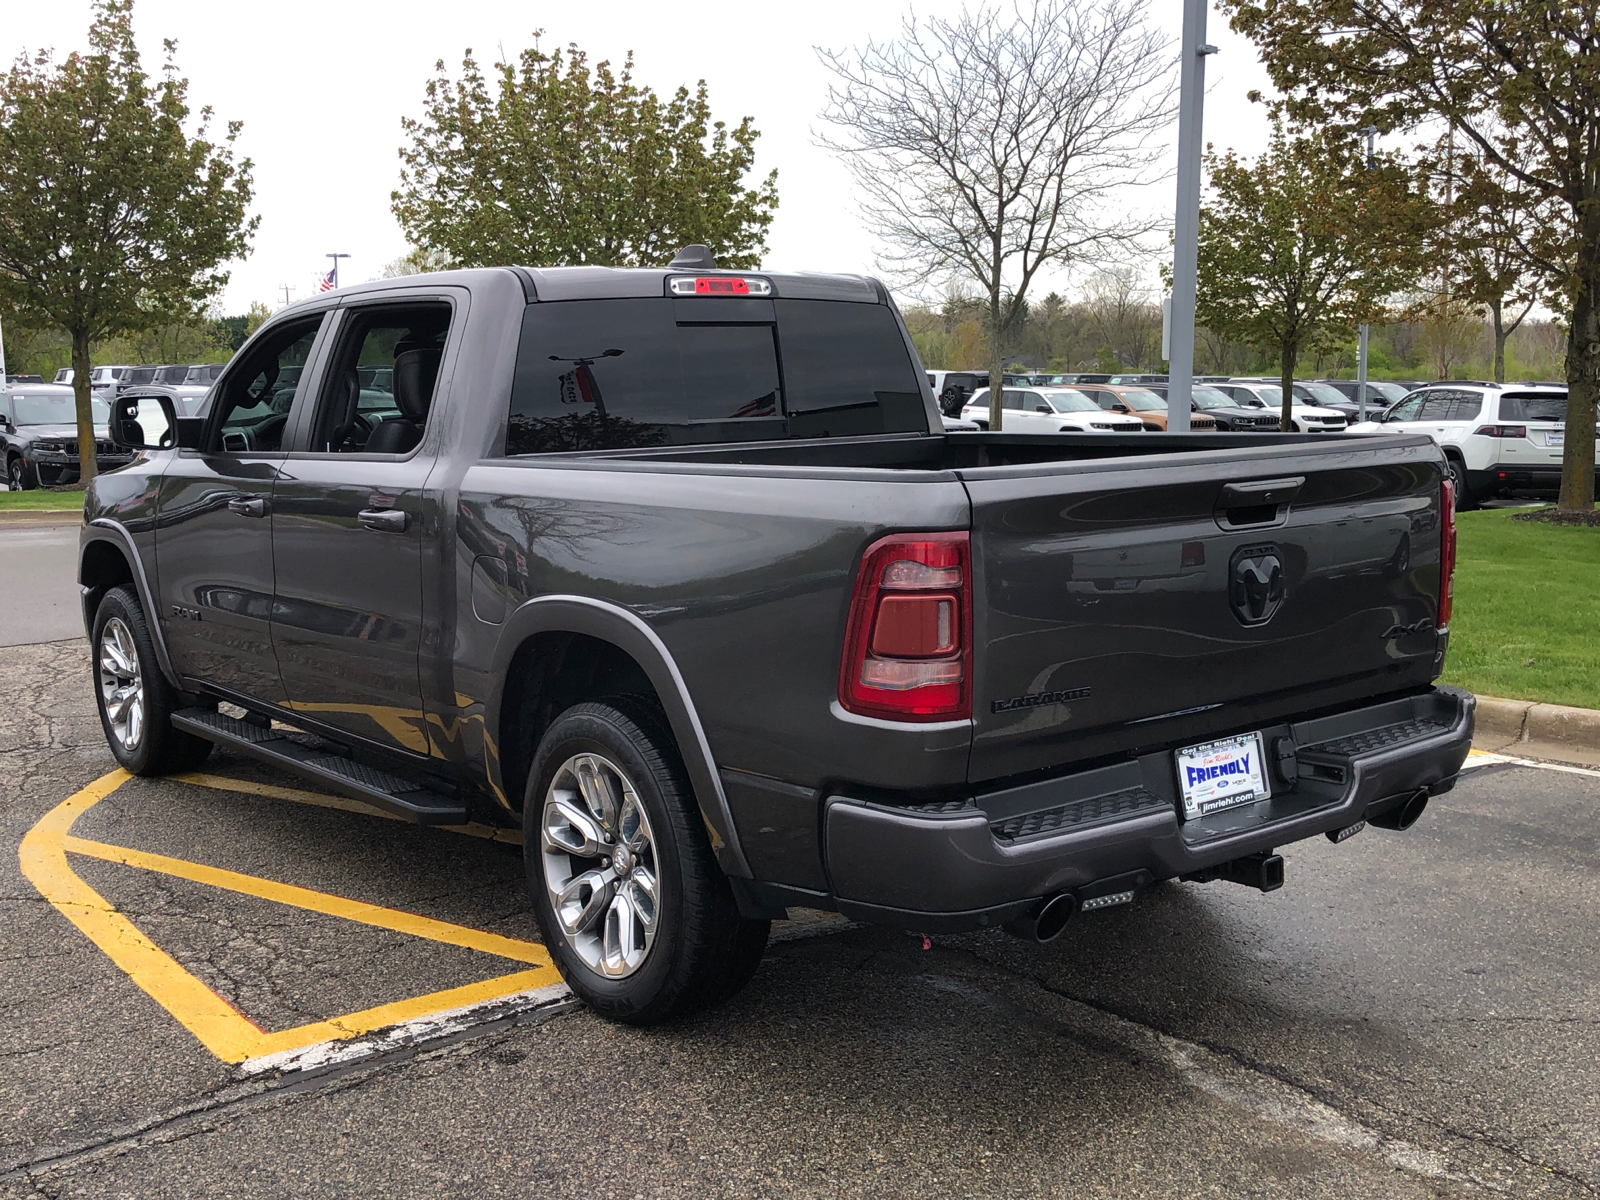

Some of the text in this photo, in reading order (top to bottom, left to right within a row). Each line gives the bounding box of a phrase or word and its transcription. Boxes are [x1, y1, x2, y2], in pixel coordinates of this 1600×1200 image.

[1244, 547, 1274, 556] RAM
[171, 604, 202, 621] RAM
[990, 686, 1091, 713] LARAMIE
[1186, 752, 1250, 788] FRIENDLY
